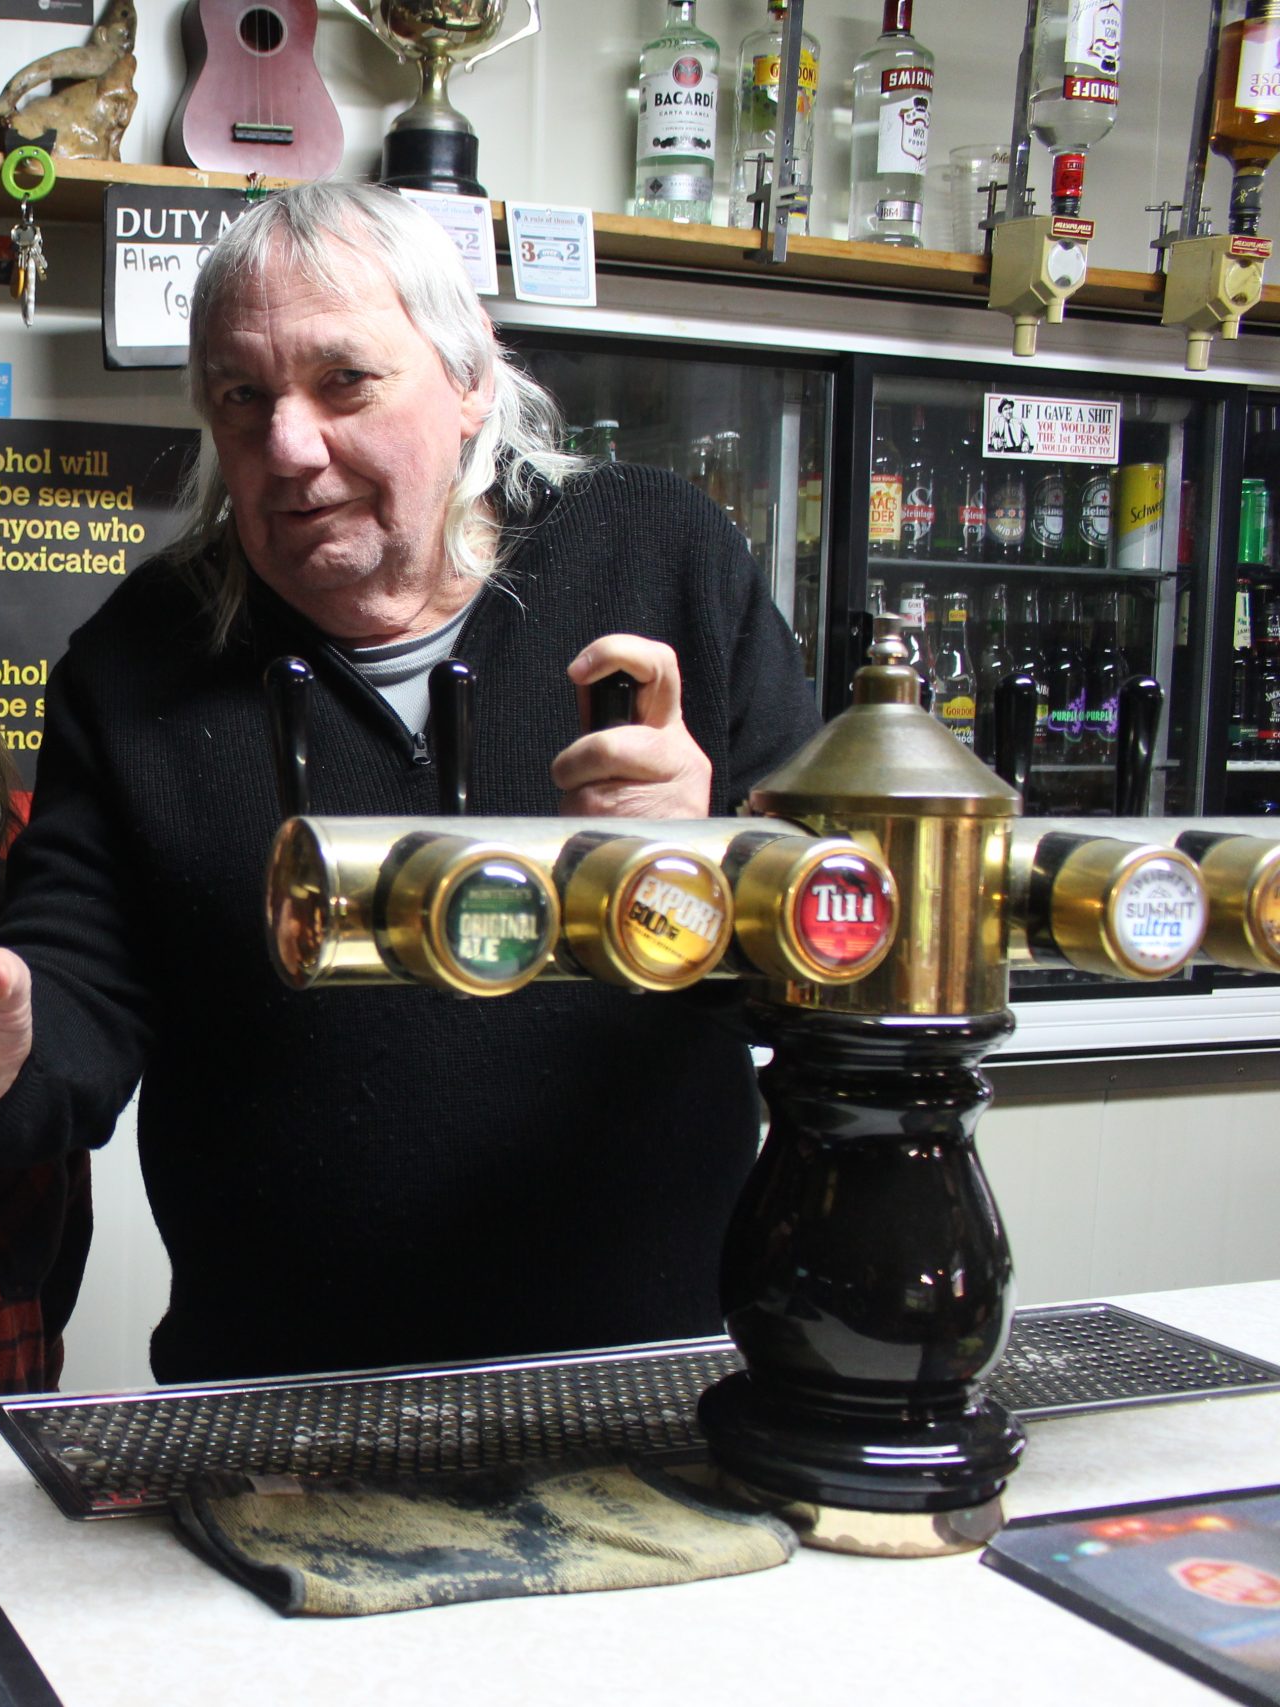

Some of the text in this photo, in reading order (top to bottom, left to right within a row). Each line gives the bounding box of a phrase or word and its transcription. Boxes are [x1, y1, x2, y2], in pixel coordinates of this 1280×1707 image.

[116, 208, 209, 239] DUTY
[123, 247, 181, 272] Alan
[1021, 404, 1033, 419] IF
[1045, 405, 1072, 421] GAVE
[1077, 408, 1084, 421] A
[1088, 408, 1113, 424] SHIT
[1037, 421, 1111, 435] YOU WOULD BE
[1037, 432, 1056, 443] THE
[1074, 434, 1111, 446] PERSON
[1041, 444, 1068, 453] WOULD
[1070, 446, 1086, 454] GIVE
[60, 451, 109, 477] will
[38, 485, 133, 511] served
[1034, 505, 1063, 516] Heine
[1082, 506, 1110, 517] Heine
[1130, 502, 1163, 523] Schwe
[88, 517, 145, 544] who
[635, 876, 723, 943] EXPORT
[1126, 901, 1195, 919] SUMMIT
[1133, 915, 1182, 937] ultra
